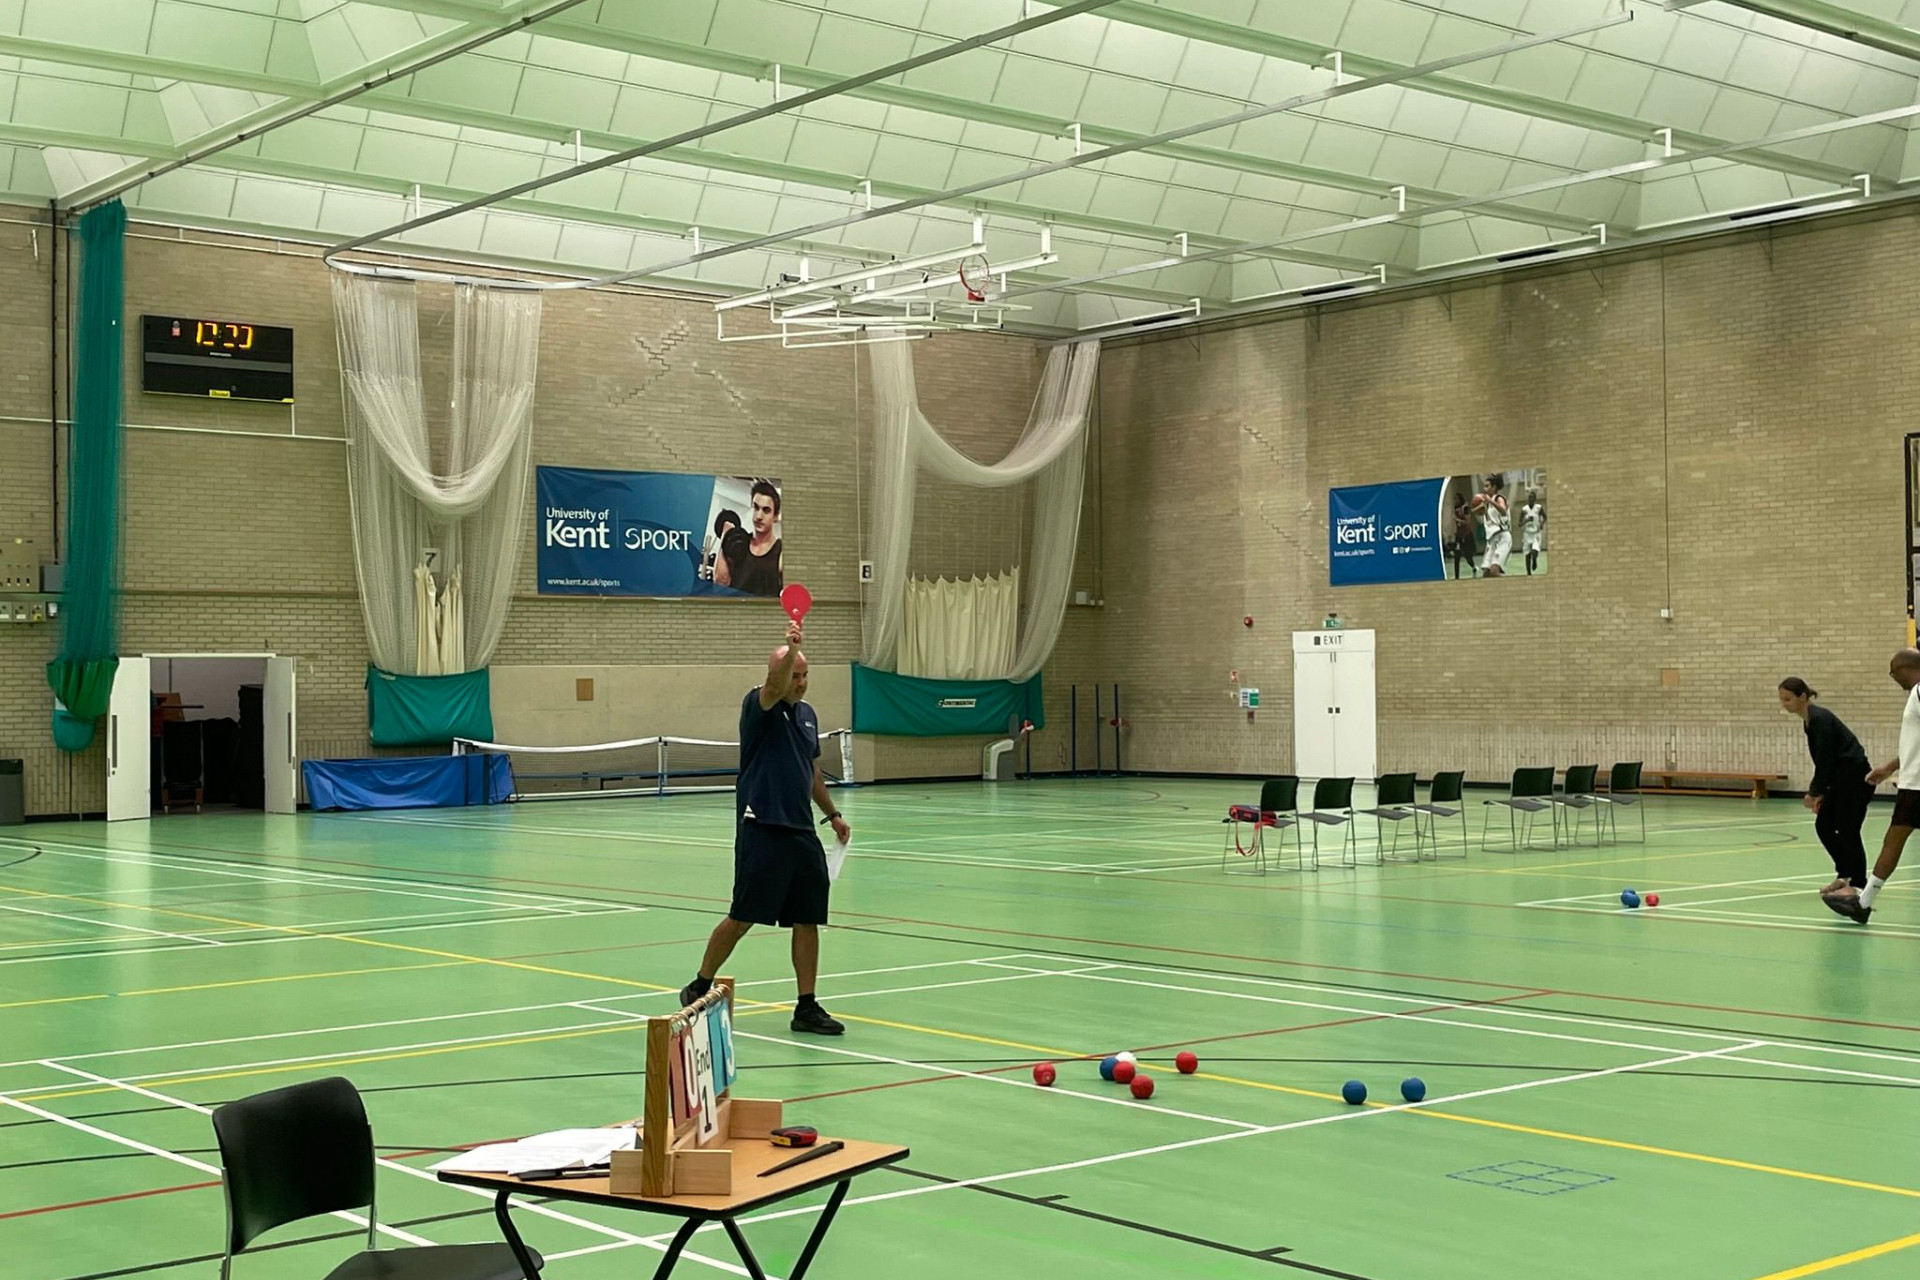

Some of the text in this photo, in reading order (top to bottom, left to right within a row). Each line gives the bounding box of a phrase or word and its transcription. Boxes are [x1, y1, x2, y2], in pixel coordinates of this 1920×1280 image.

[546, 507, 610, 523] University of
[1337, 514, 1375, 525] University of
[546, 519, 692, 551] Kent SPORT
[1337, 523, 1428, 544] Kent SPORT
[425, 552, 437, 568] 7
[547, 578, 620, 588] www.kent.ac.uk/sports
[1323, 635, 1343, 645] EXIT
[696, 1041, 711, 1076] End
[684, 1034, 699, 1109] 0
[702, 1085, 713, 1134] 1
